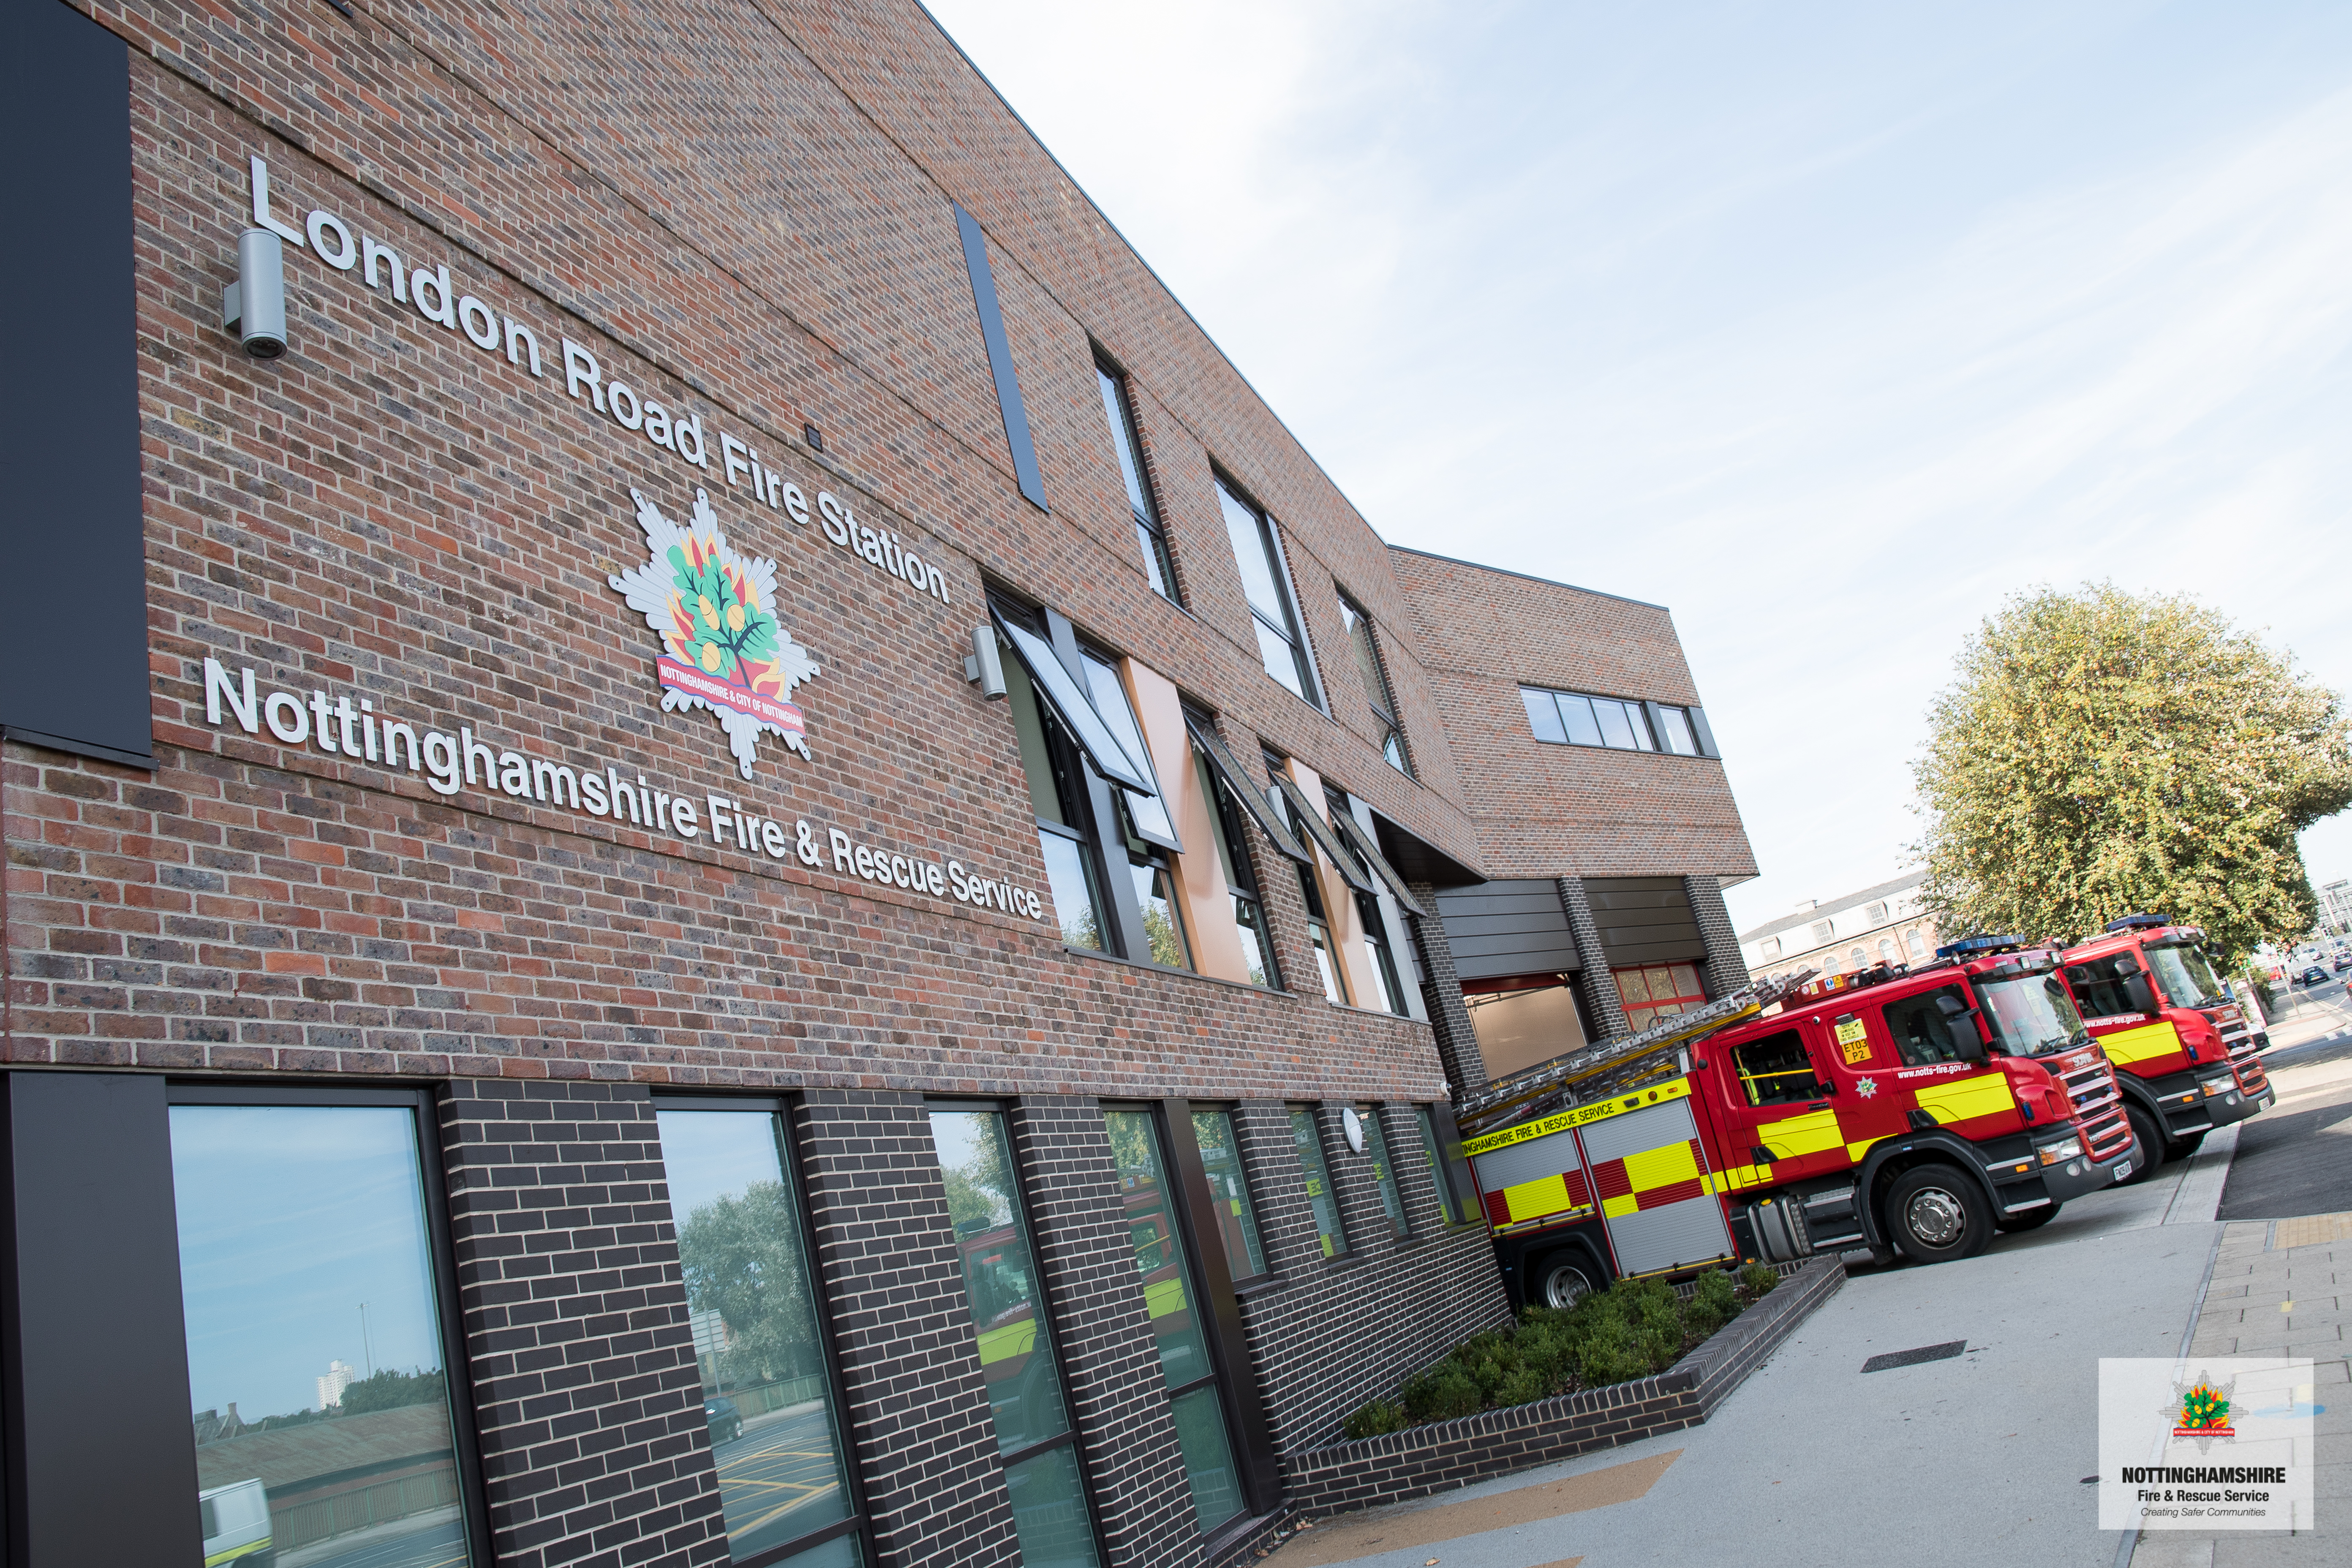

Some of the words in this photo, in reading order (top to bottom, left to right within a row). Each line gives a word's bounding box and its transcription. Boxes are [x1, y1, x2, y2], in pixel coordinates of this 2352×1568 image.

[251, 155, 542, 378] London
[562, 338, 707, 469] Road
[720, 431, 809, 524] Fire
[818, 491, 950, 604] Station
[660, 664, 729, 700] NOTTINGHAMSHIRE
[730, 690, 735, 702] &
[736, 692, 751, 708] CITY
[752, 700, 762, 712] OF
[762, 701, 803, 727] NOTTINGHAM
[204, 657, 698, 838] Nottinghamshire
[707, 794, 786, 858] Fire
[796, 819, 823, 867] &
[828, 827, 945, 896] Rescue
[947, 860, 1042, 920] Service
[1852, 1051, 1865, 1061] P2
[1897, 1062, 1972, 1079] www.notts-fire.gov.uk
[1462, 1132, 1514, 1154] INGHAMSHIRE
[1516, 1128, 1533, 1139] FIRE
[1536, 1124, 1541, 1134] &
[1544, 1113, 1577, 1132] RESCUE
[1579, 1102, 1614, 1122] SERVICE
